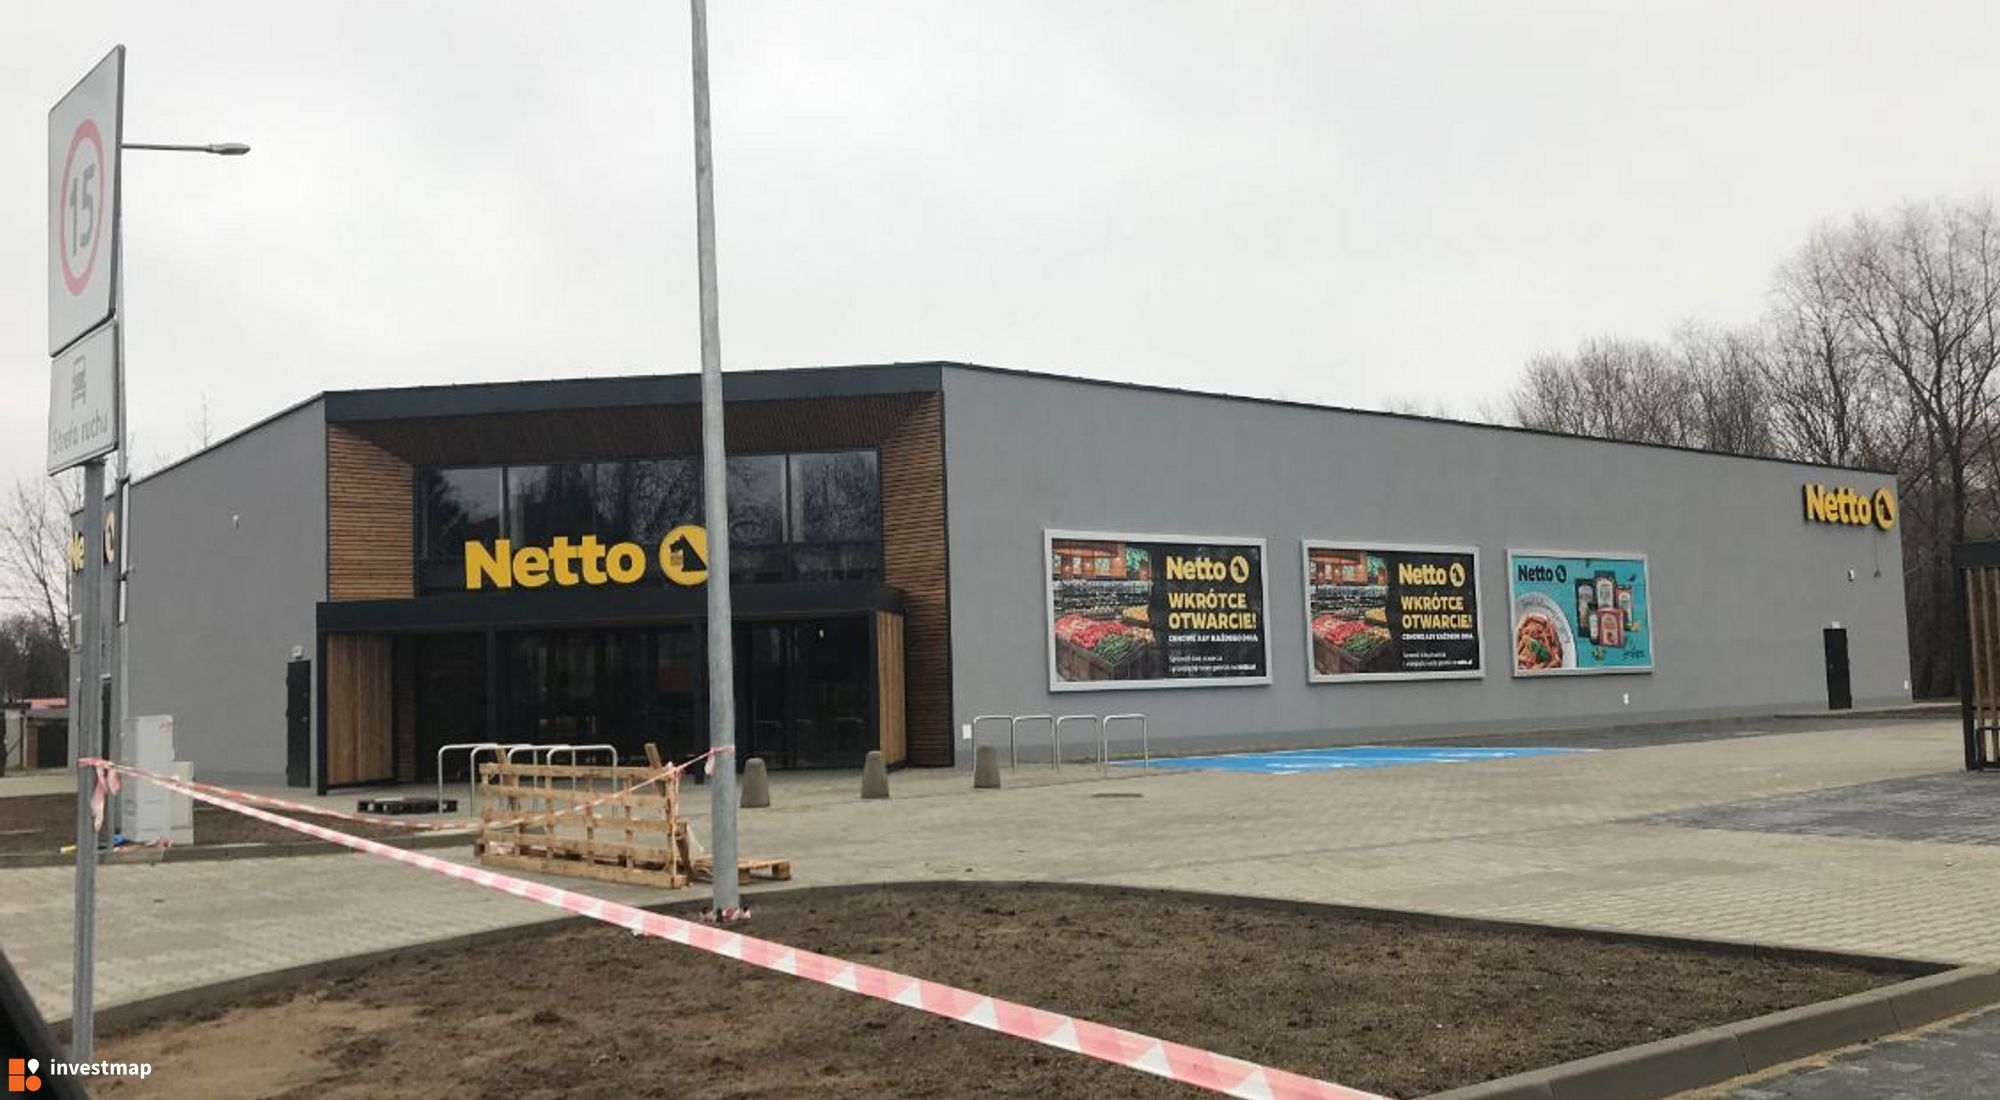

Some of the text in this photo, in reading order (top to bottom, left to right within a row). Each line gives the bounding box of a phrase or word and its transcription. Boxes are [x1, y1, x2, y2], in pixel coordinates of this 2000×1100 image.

[70, 163, 95, 256] 15
[1803, 483, 1872, 525] Netto
[464, 534, 646, 590] Netto
[1166, 555, 1227, 581] Netto
[1517, 564, 1554, 582] Netto
[1398, 562, 1447, 585] Netto
[1167, 588, 1247, 609] WKRÓTCE
[1401, 591, 1464, 611] WKRÓTCE
[1168, 612, 1257, 630] OTWARCIE!
[1402, 613, 1473, 630] OTWARCIE!
